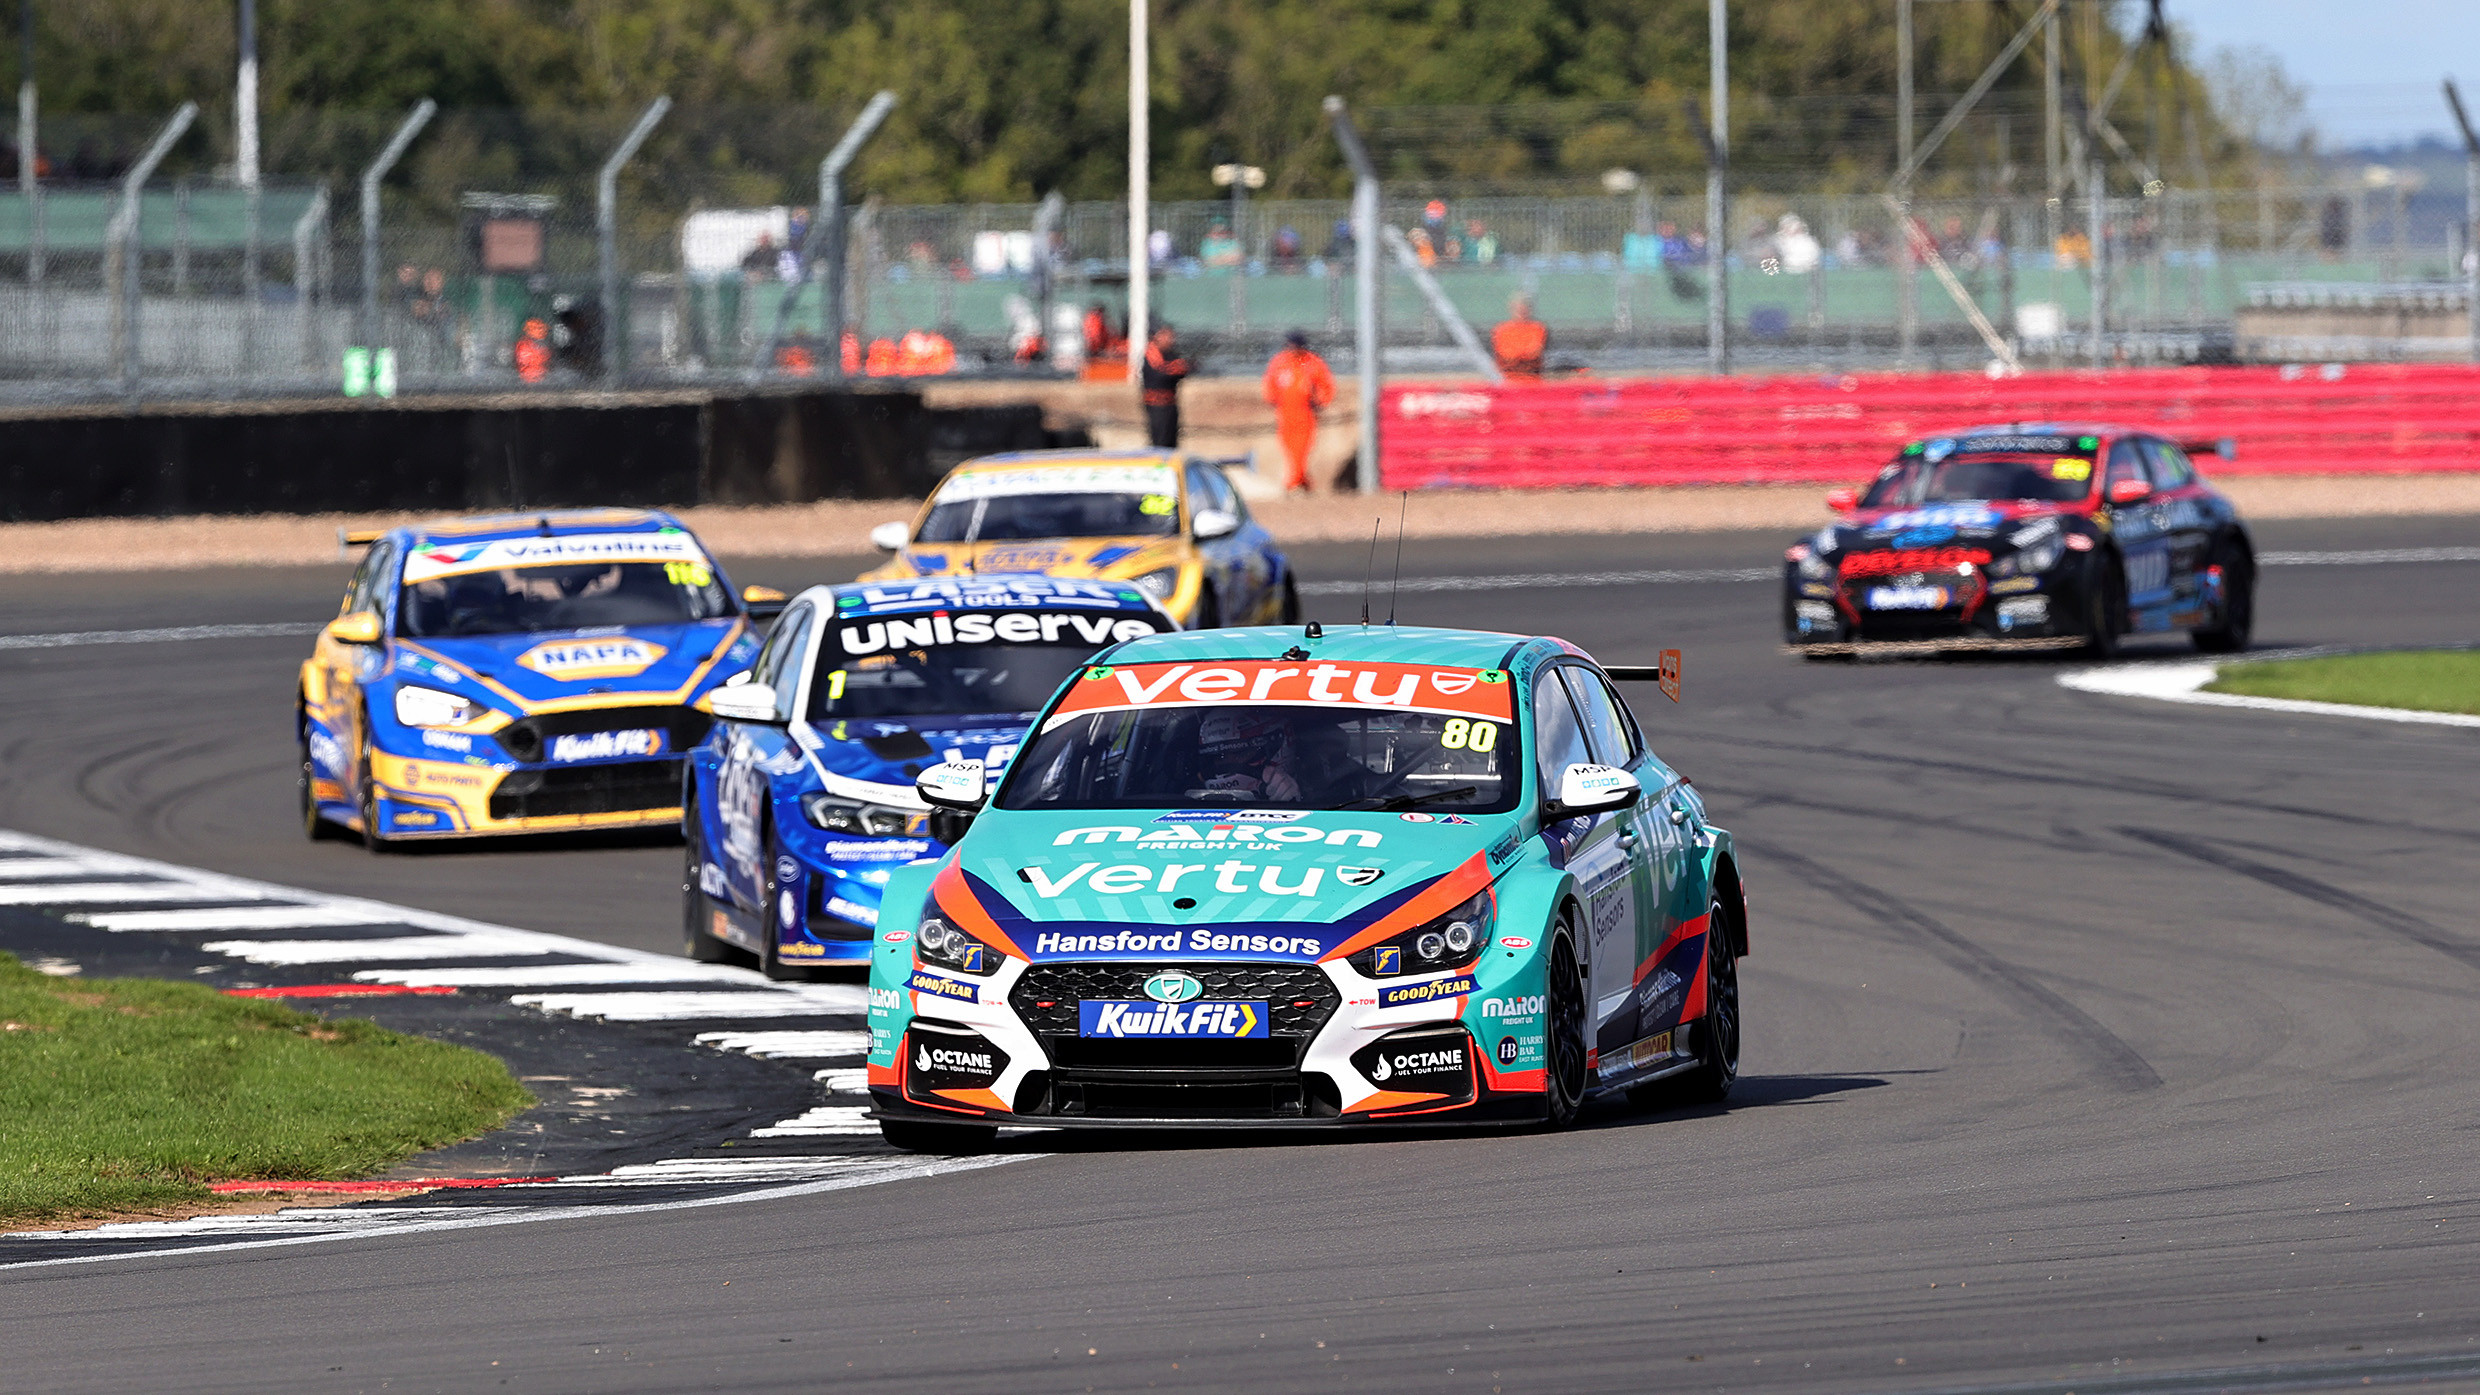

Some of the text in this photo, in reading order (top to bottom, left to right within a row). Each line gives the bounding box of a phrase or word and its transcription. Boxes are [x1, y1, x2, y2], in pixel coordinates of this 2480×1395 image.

[505, 540, 683, 558] Valvoline
[951, 592, 1041, 608] TOOLS
[542, 644, 642, 665] NAPA
[828, 670, 847, 699] 1
[1115, 664, 1421, 706] Vertu
[1441, 718, 1498, 753] 80
[943, 762, 980, 772] MSP
[1136, 841, 1284, 851] FREIGHT UK
[1024, 859, 1325, 899] Vertu
[888, 932, 908, 941] ABS
[1035, 929, 1321, 956] Hansford Sensors
[1504, 938, 1529, 946] ABS
[912, 975, 973, 999] GOODYEAR
[1387, 980, 1471, 1003] GOODYEAR
[1359, 998, 1376, 1006] TOW
[1502, 1016, 1534, 1026] FREIGHT UK
[932, 1048, 993, 1069] OCTANE
[1393, 1049, 1463, 1069] OCTANE
[1500, 1042, 1518, 1059] HB
[1519, 1046, 1536, 1056] BAR
[933, 1063, 993, 1076] FUEL YOUR FINANCE
[1395, 1064, 1464, 1076] UEL YOUR FINANCE
